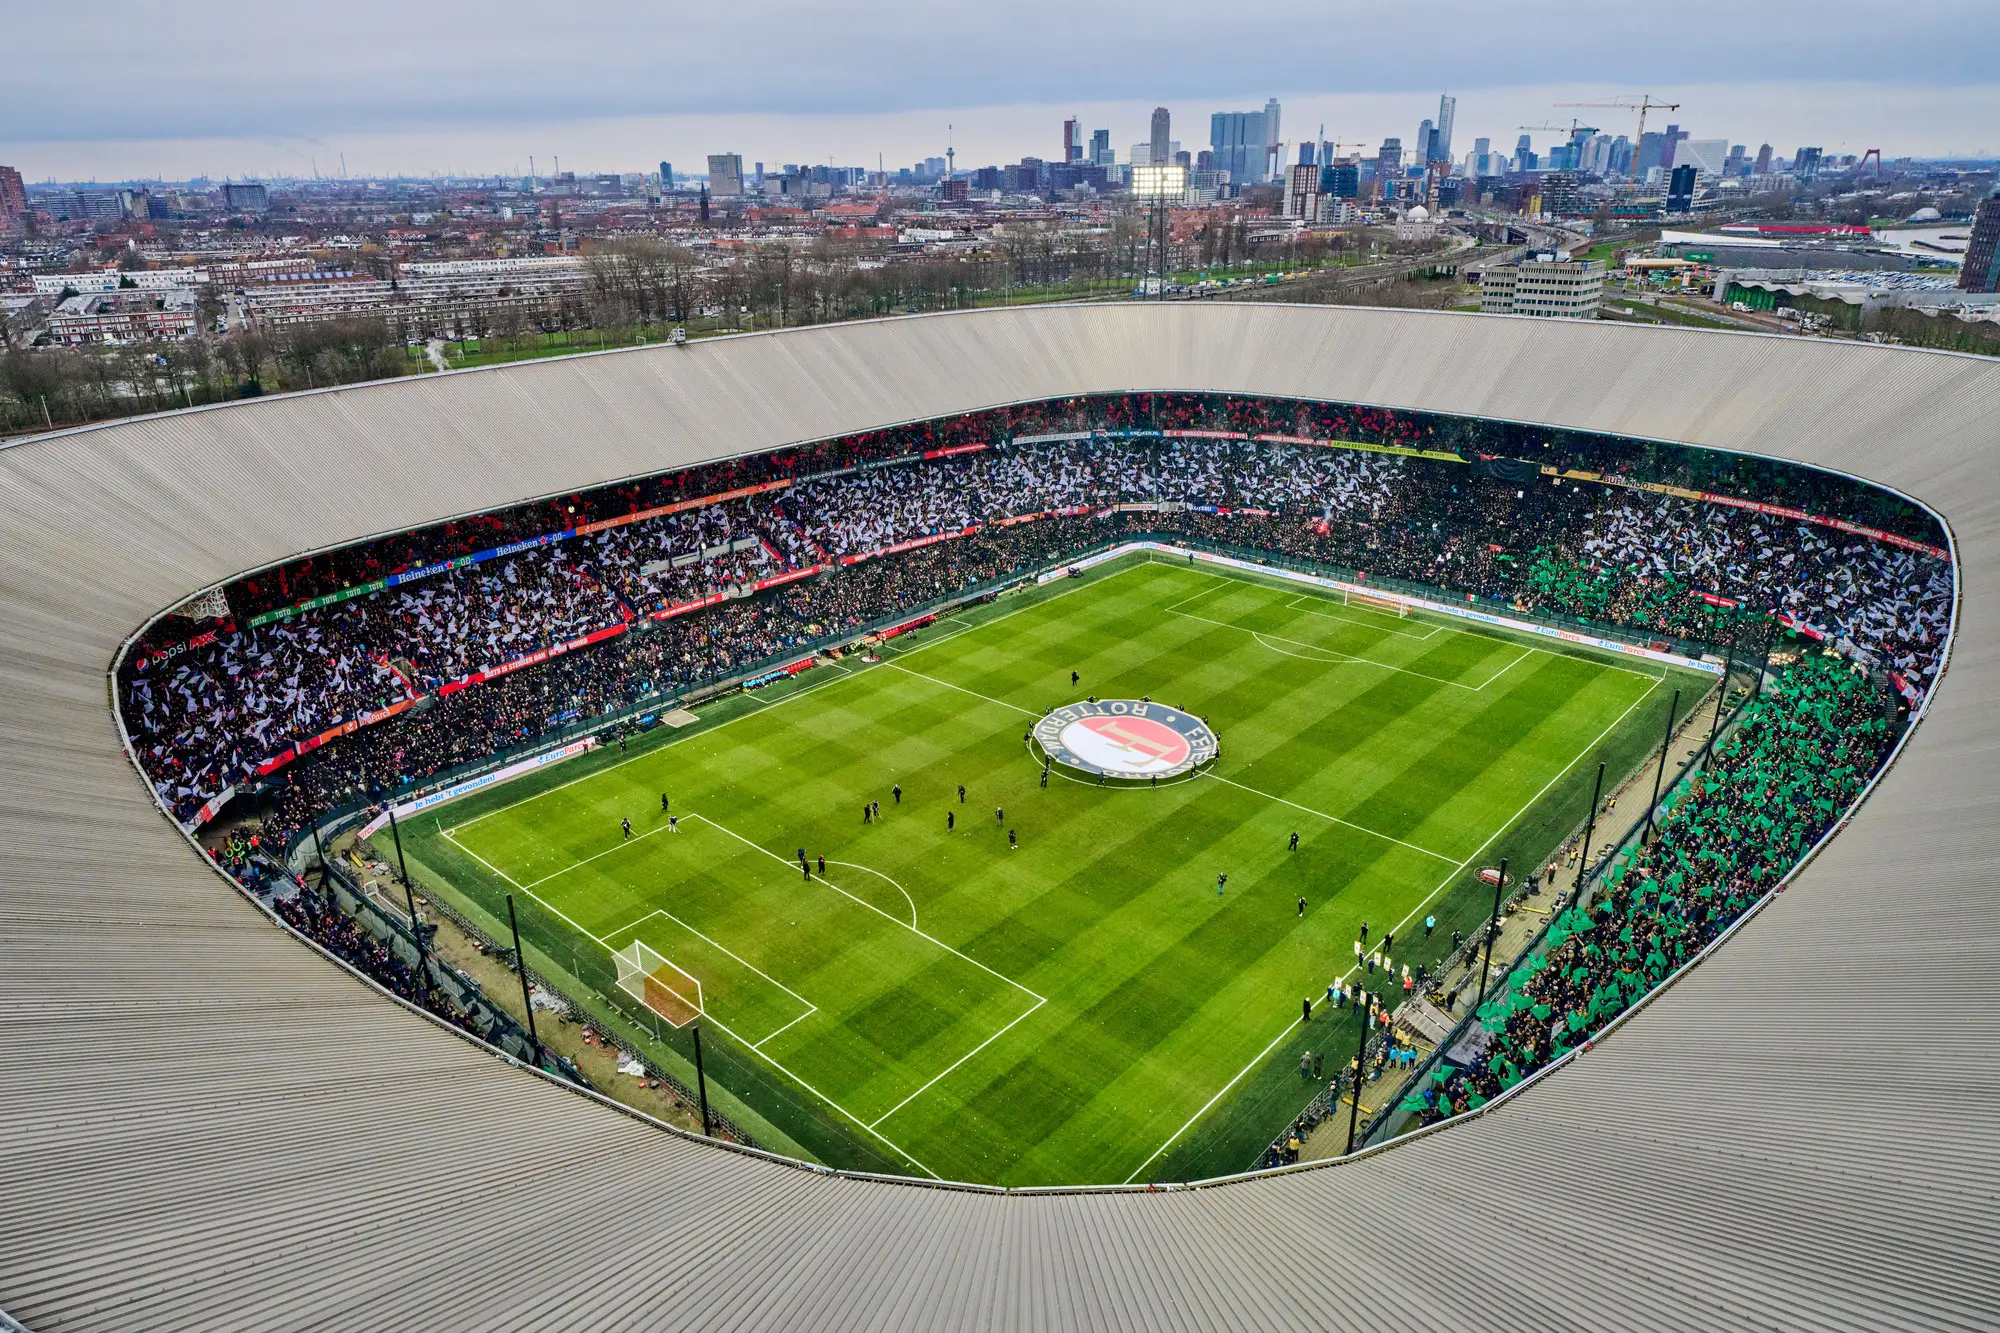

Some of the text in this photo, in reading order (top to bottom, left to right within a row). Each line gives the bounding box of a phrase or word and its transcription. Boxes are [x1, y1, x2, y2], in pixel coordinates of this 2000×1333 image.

[1603, 475, 1648, 489] BURNDO
[496, 539, 538, 557] Heineken
[398, 564, 444, 584] Heineken
[345, 588, 361, 598] TOTO
[369, 581, 384, 592] TOTO
[300, 601, 316, 611] TOTO
[321, 594, 337, 605] TOTO
[274, 608, 291, 619] TOTO
[1444, 606, 1459, 615] hebt
[1465, 611, 1499, 624] gevonden!
[251, 616, 267, 627] TOTO
[1541, 626, 1580, 642] EuroParcs
[1604, 640, 1646, 657] EuroParcs
[509, 656, 534, 670] STEKER
[1688, 659, 1696, 668] Je
[1697, 661, 1715, 672] hebt
[544, 741, 586, 763] EuroParc
[415, 800, 423, 811] Je
[425, 792, 445, 806] hebt
[453, 774, 496, 797] gevonden!
